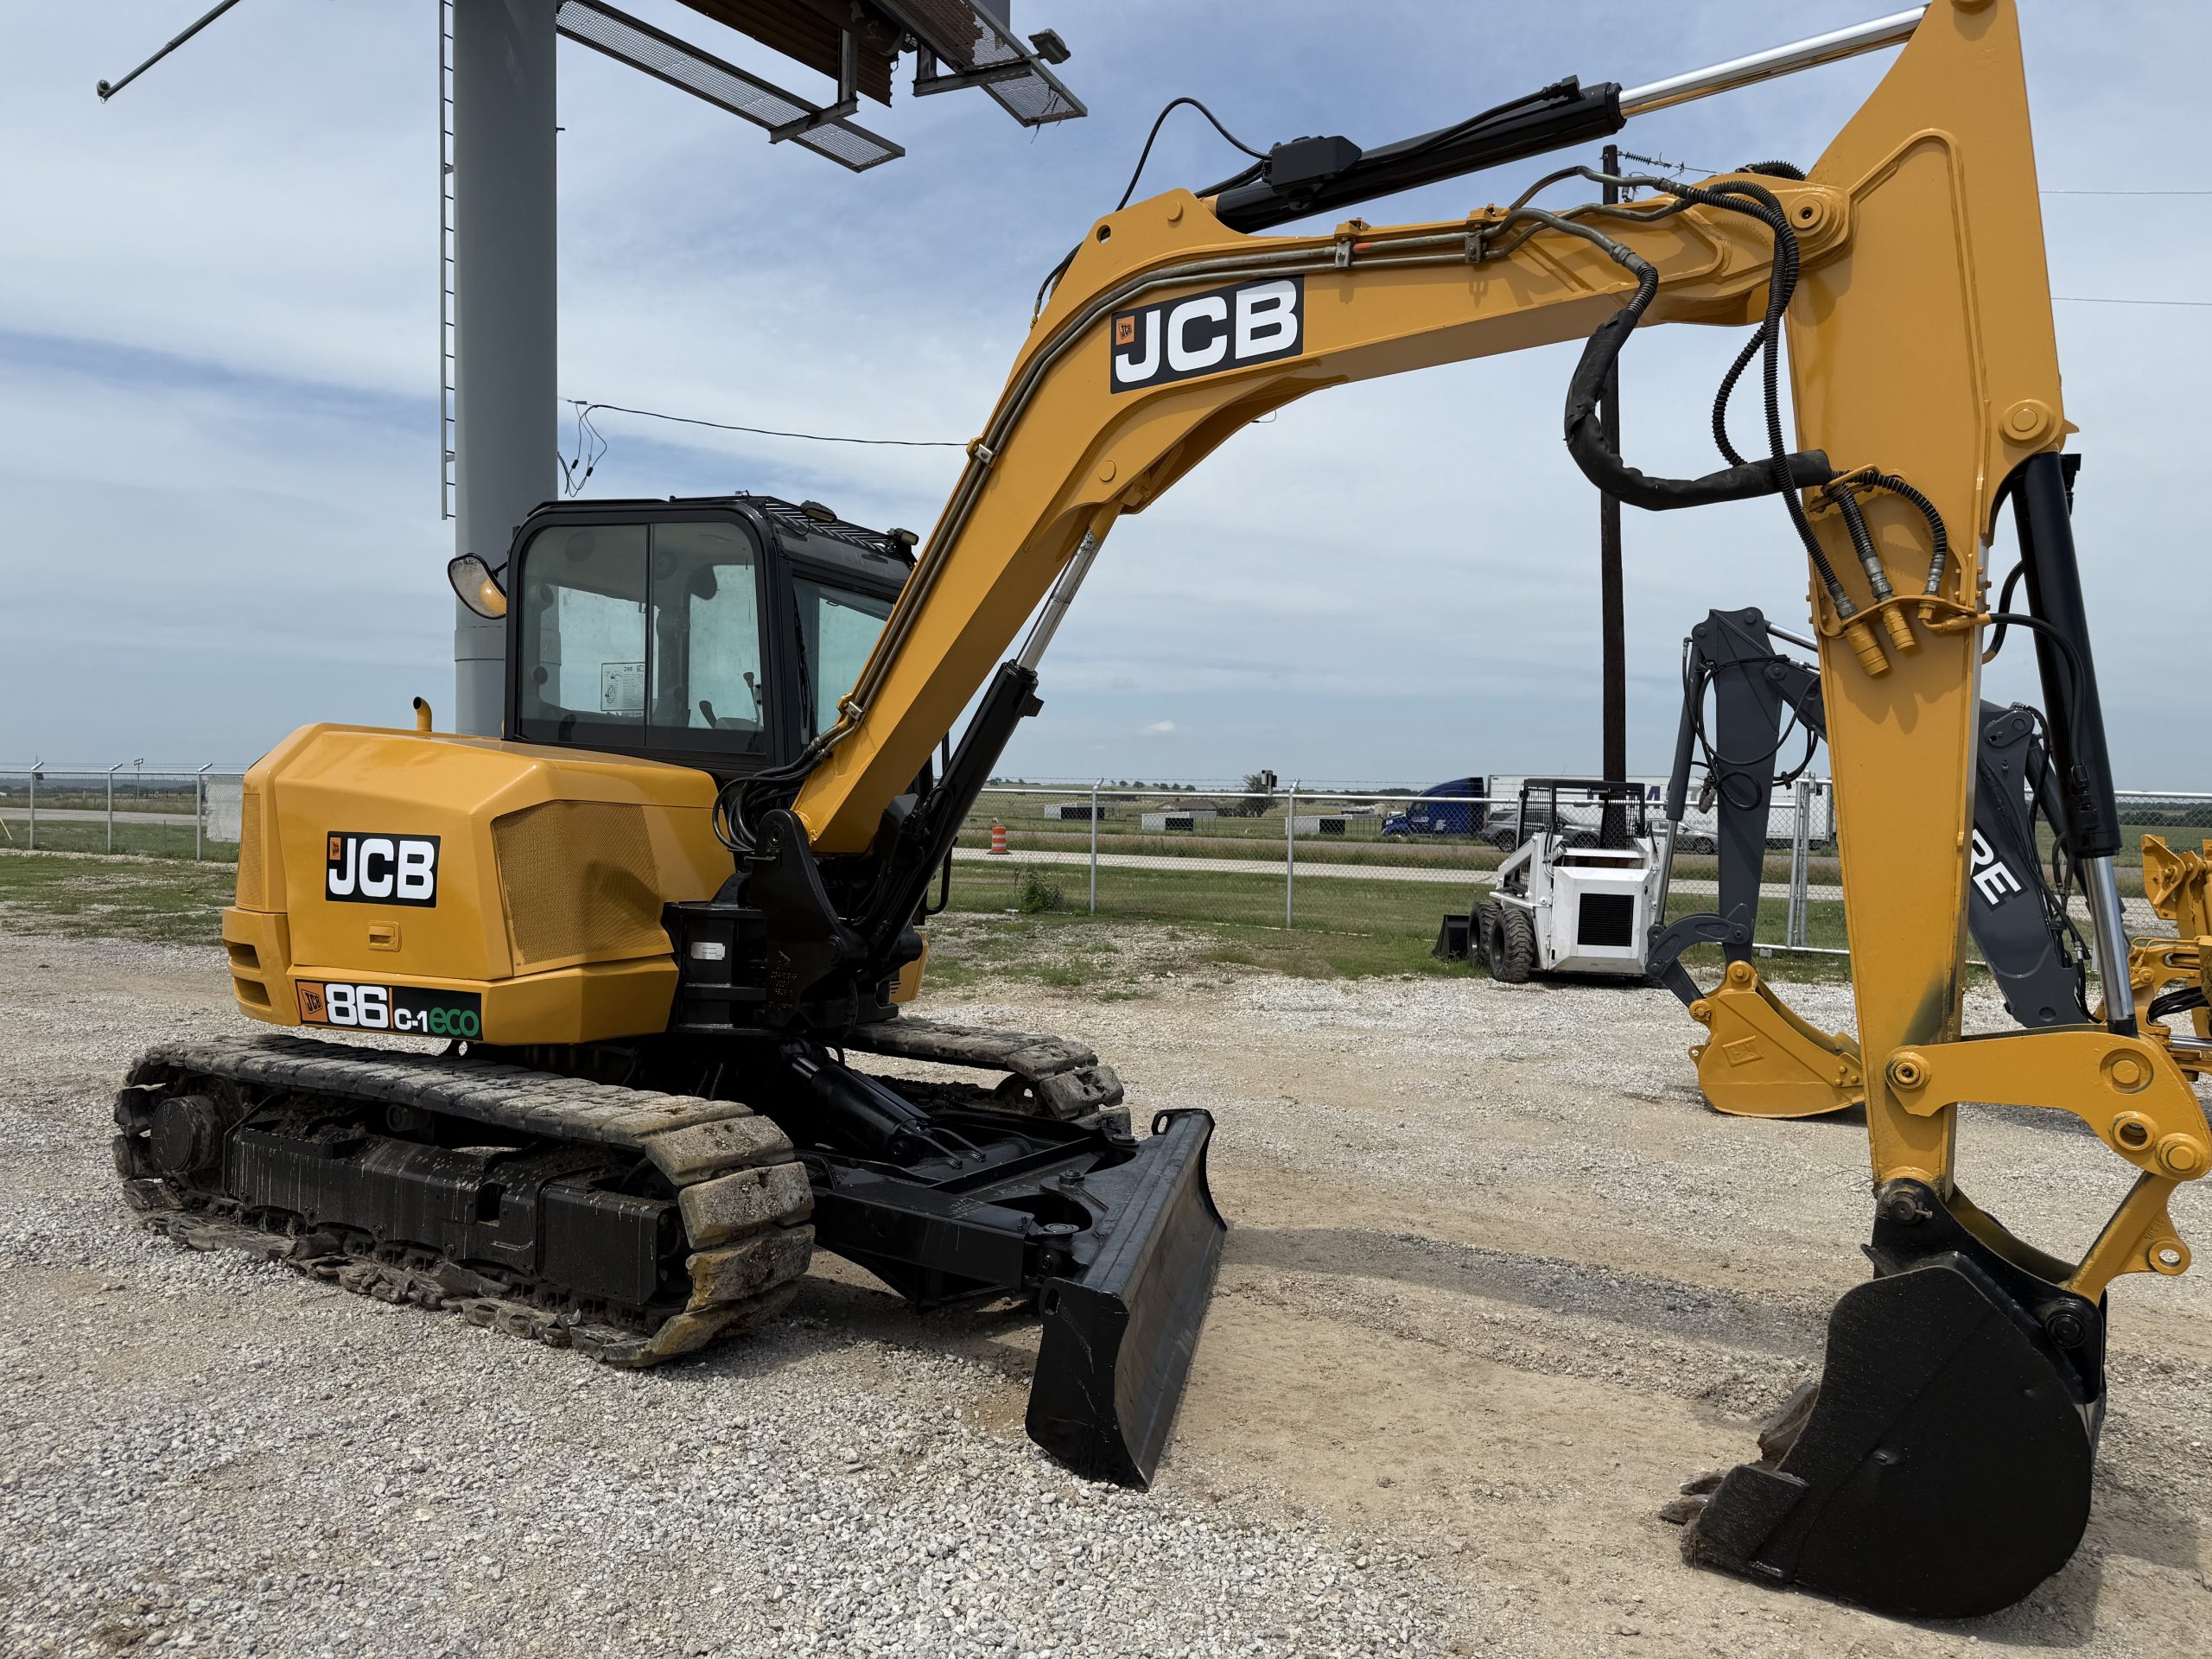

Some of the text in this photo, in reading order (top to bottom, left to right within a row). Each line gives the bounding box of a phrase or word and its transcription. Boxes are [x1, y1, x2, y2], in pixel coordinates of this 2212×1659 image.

[1116, 280, 1298, 383] JCB
[328, 837, 435, 900] JCB
[305, 991, 323, 1013] JCB
[325, 983, 389, 1028] 86
[429, 1007, 480, 1037] eco
